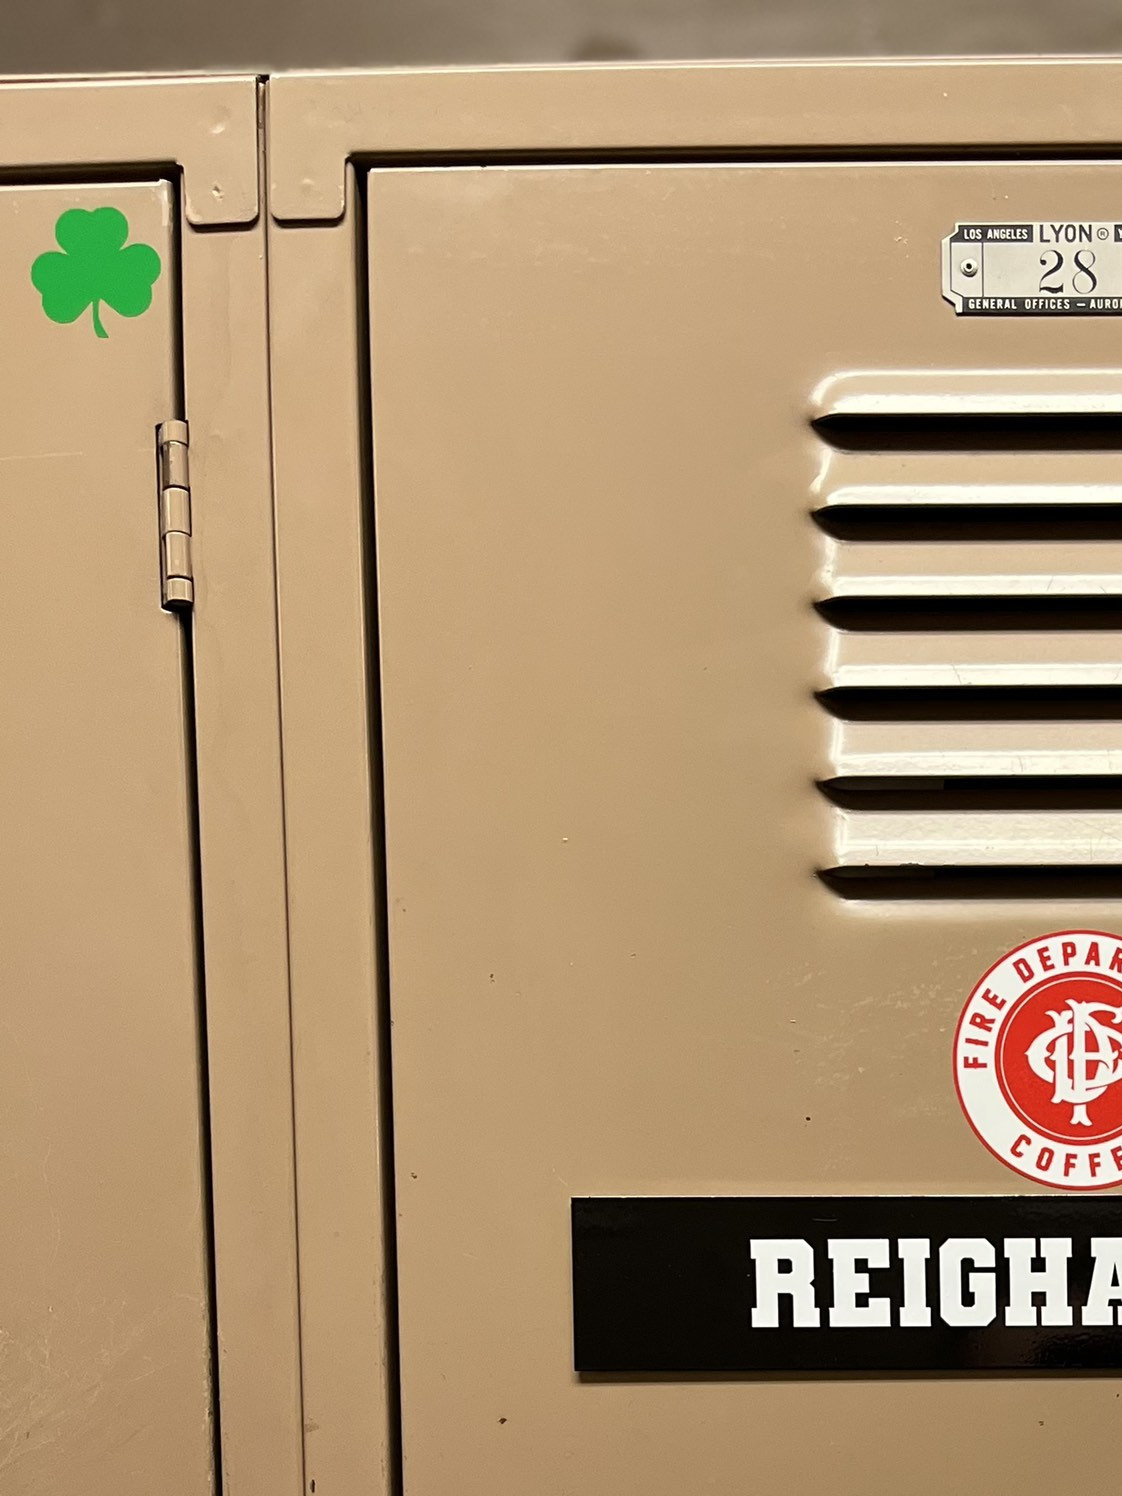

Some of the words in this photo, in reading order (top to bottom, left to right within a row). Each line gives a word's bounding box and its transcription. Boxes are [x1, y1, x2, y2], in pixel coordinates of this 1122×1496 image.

[963, 228, 982, 240] LOS
[986, 228, 1028, 240] ANGELES
[1038, 249, 1098, 295] 28
[968, 299, 1017, 310] GENERAL
[1024, 299, 1070, 310] OFFICES
[963, 987, 1007, 1070] FIRE
